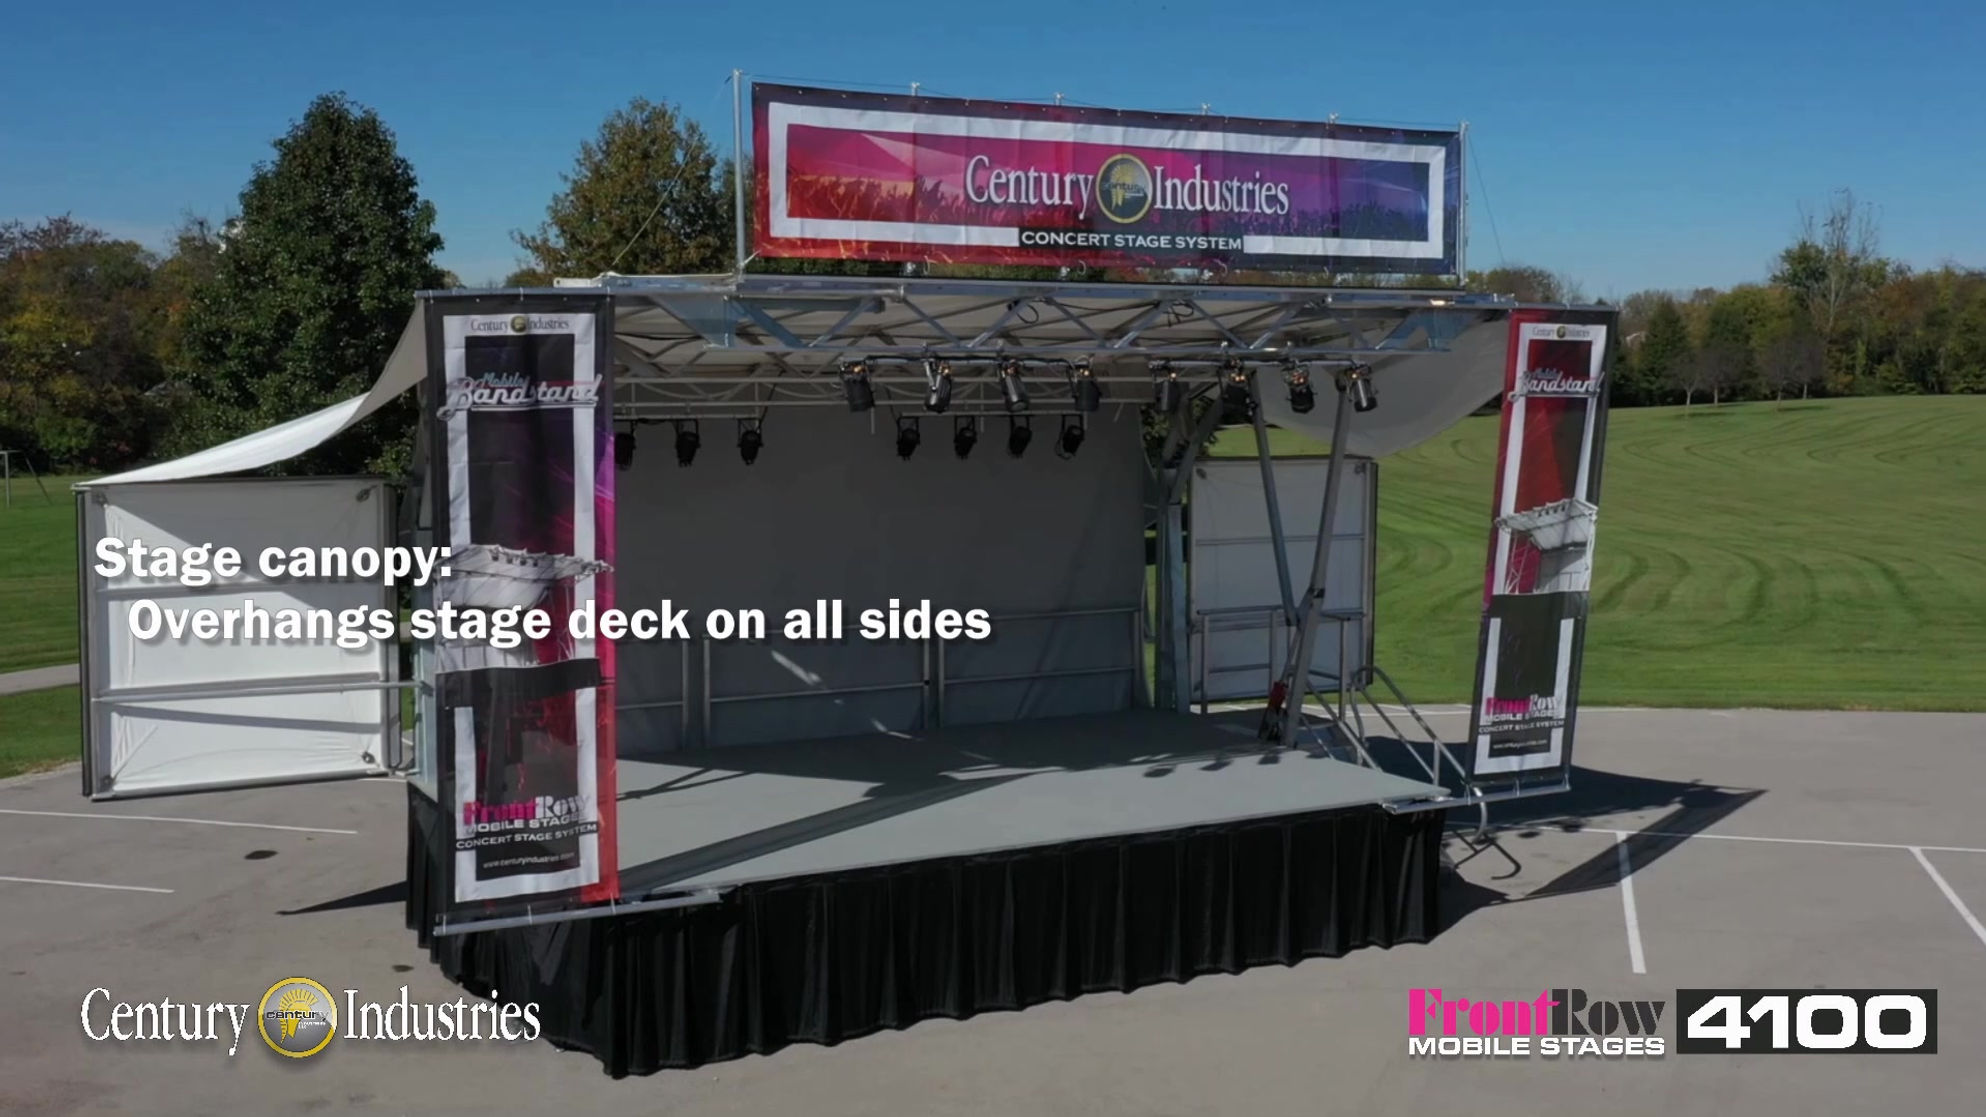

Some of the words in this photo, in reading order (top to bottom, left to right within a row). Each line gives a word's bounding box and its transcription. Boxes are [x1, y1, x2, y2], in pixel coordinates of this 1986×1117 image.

[966, 155, 1093, 219] Century
[1153, 164, 1289, 215] Industries
[1021, 231, 1111, 247] CONCERT
[1114, 234, 1171, 248] STAGE
[1175, 236, 1242, 250] SYSTEM
[470, 319, 509, 332] Century
[527, 317, 570, 330] Industries
[437, 373, 602, 421] Bandstand
[1479, 723, 1514, 734] CONCERT
[1536, 720, 1564, 729] SYSTEM
[456, 834, 511, 849] CONCERT
[514, 831, 552, 843] STAGE
[555, 823, 597, 838] SYSTEM
[465, 818, 524, 836] MOBILE
[482, 852, 575, 869] www.centuryindustries.com
